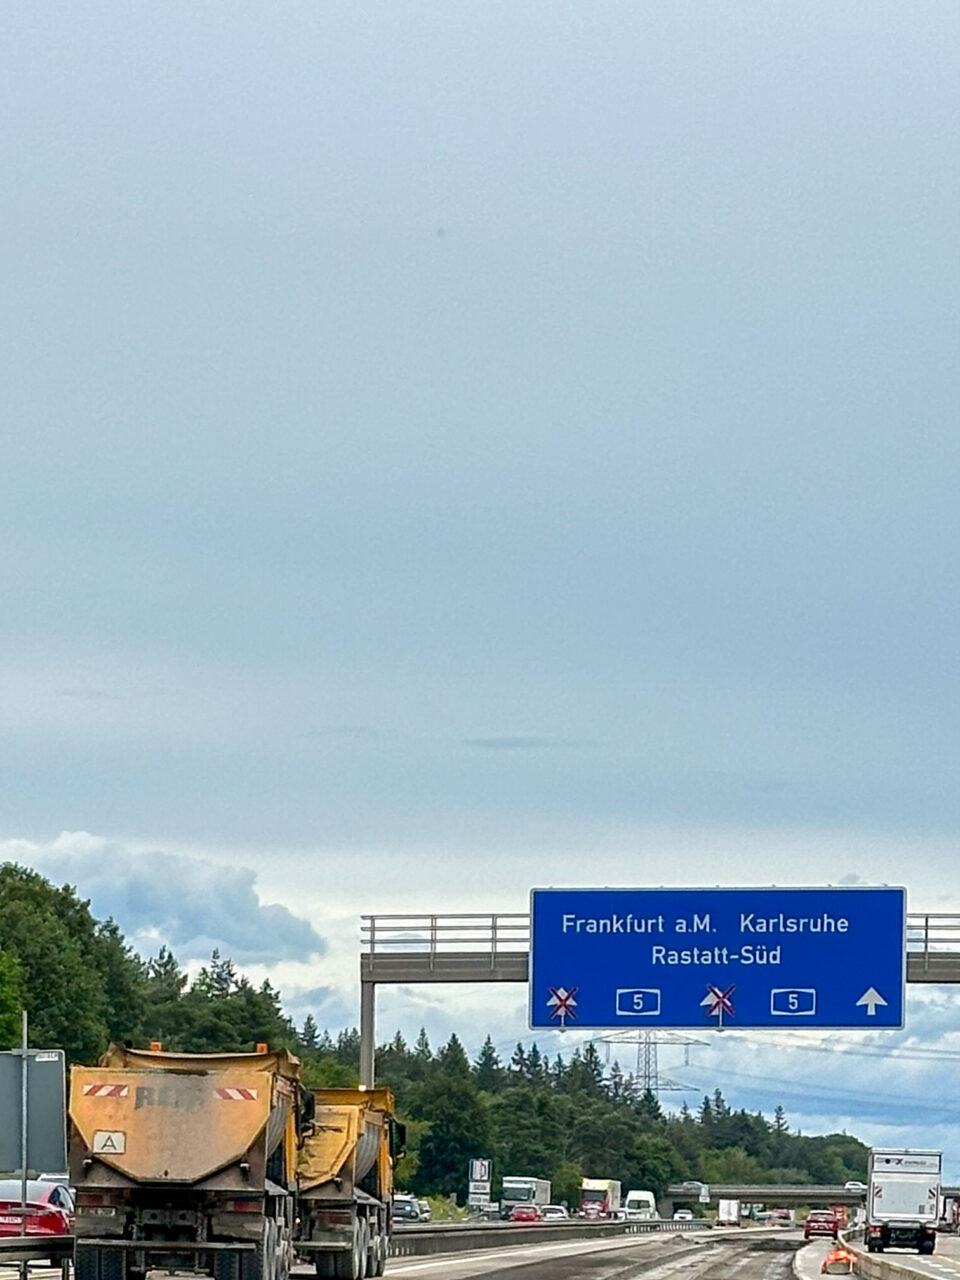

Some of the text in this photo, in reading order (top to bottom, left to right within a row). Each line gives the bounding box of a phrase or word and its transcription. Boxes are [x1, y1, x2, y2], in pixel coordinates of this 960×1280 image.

[562, 914, 717, 933] Frankfurt a.M.
[739, 913, 849, 933] Karlsruhe
[651, 945, 781, 965] Rastatt-Süd
[633, 994, 644, 1010] 5
[788, 994, 798, 1010] 5
[101, 1136, 117, 1150] A
